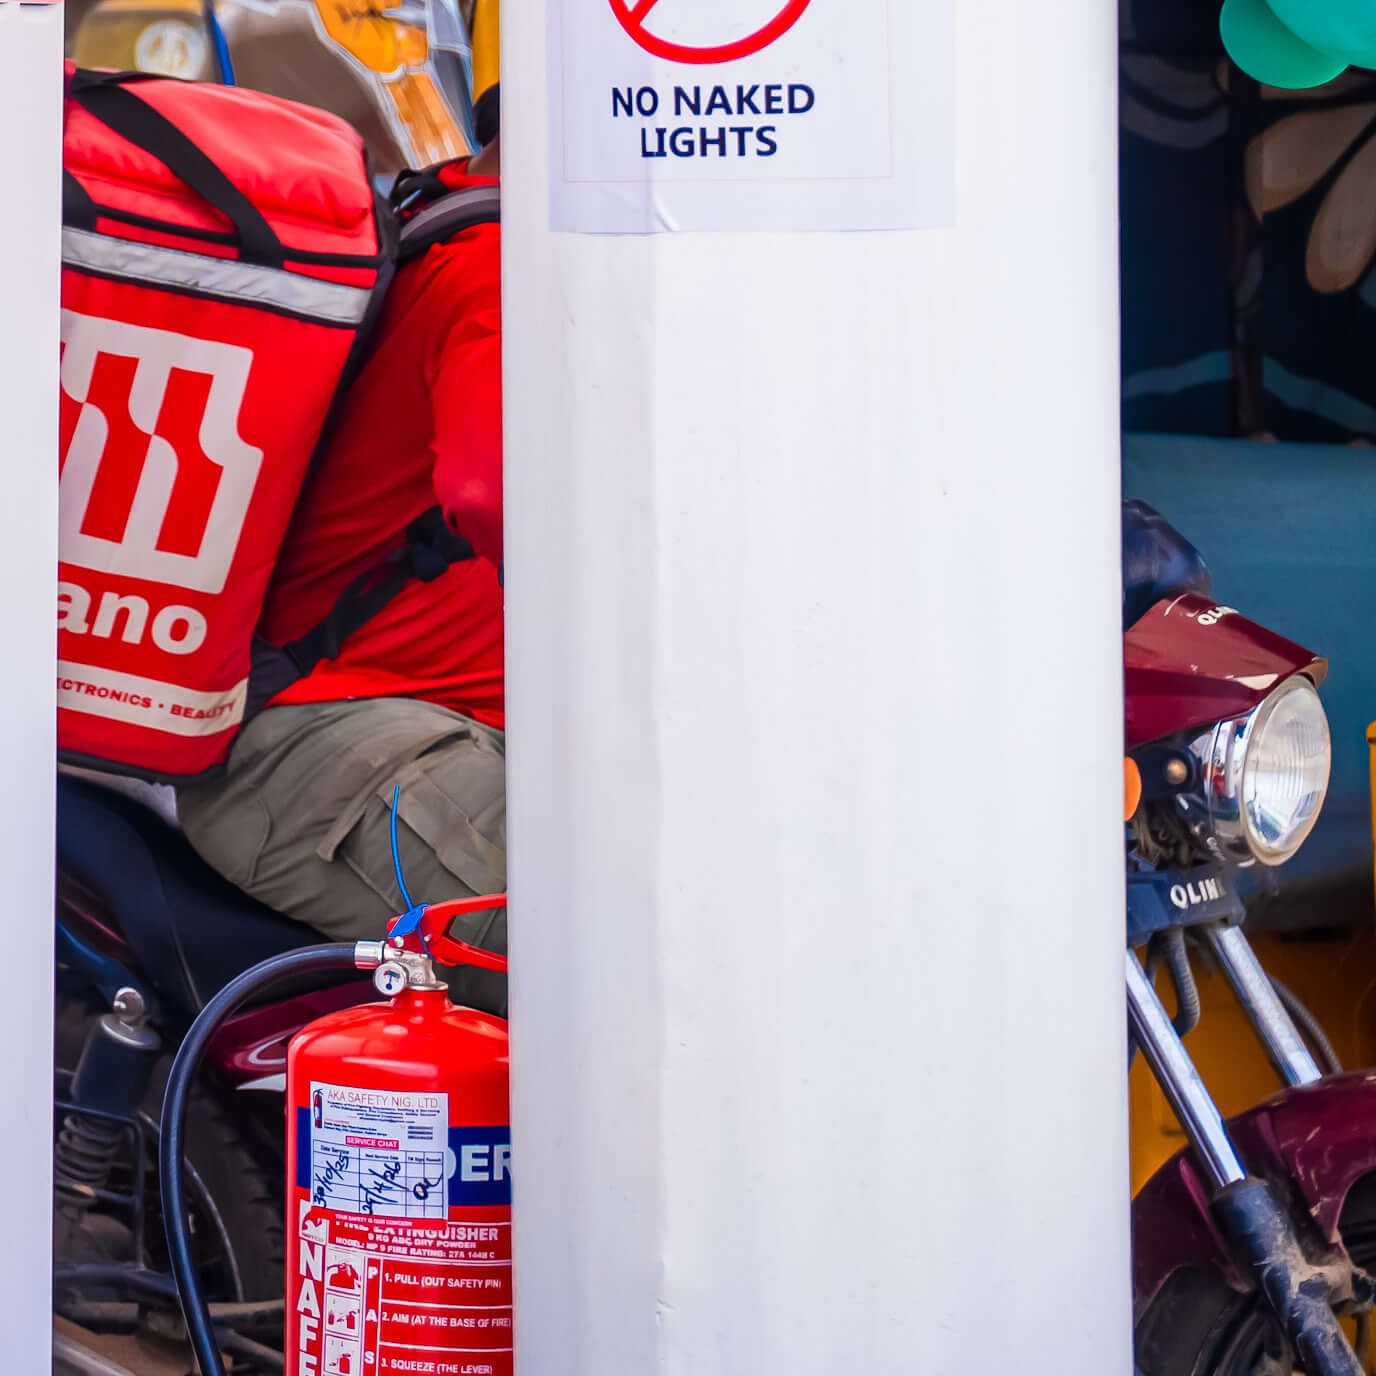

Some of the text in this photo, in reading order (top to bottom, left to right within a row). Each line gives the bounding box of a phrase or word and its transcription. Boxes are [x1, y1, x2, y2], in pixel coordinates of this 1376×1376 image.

[612, 83, 815, 117] NO NAKED
[641, 125, 778, 157] LIGHTS
[170, 699, 237, 720] BEAUTY
[348, 1092, 388, 1106] SAFETY
[346, 1136, 398, 1148] SERVICE CHAT
[392, 1236, 412, 1246] ABC
[414, 1238, 434, 1247] DRY
[436, 1240, 477, 1249] POWDER
[387, 1245, 408, 1254] FIRE
[410, 1247, 446, 1258] RATING:
[367, 1266, 378, 1280] P
[384, 1272, 392, 1283] 1.
[394, 1274, 419, 1285] PULL
[421, 1276, 445, 1288] (OUT
[447, 1278, 483, 1289] SAFETY
[365, 1309, 377, 1322] A
[382, 1313, 390, 1321] 2.
[391, 1313, 409, 1323] AIM
[411, 1315, 426, 1325] (AT
[429, 1316, 448, 1327] THE
[450, 1317, 476, 1328] BASE
[477, 1318, 488, 1328] OF
[364, 1351, 374, 1364] S
[381, 1358, 493, 1375] 3. SQUEEZE (THE LEVER)
